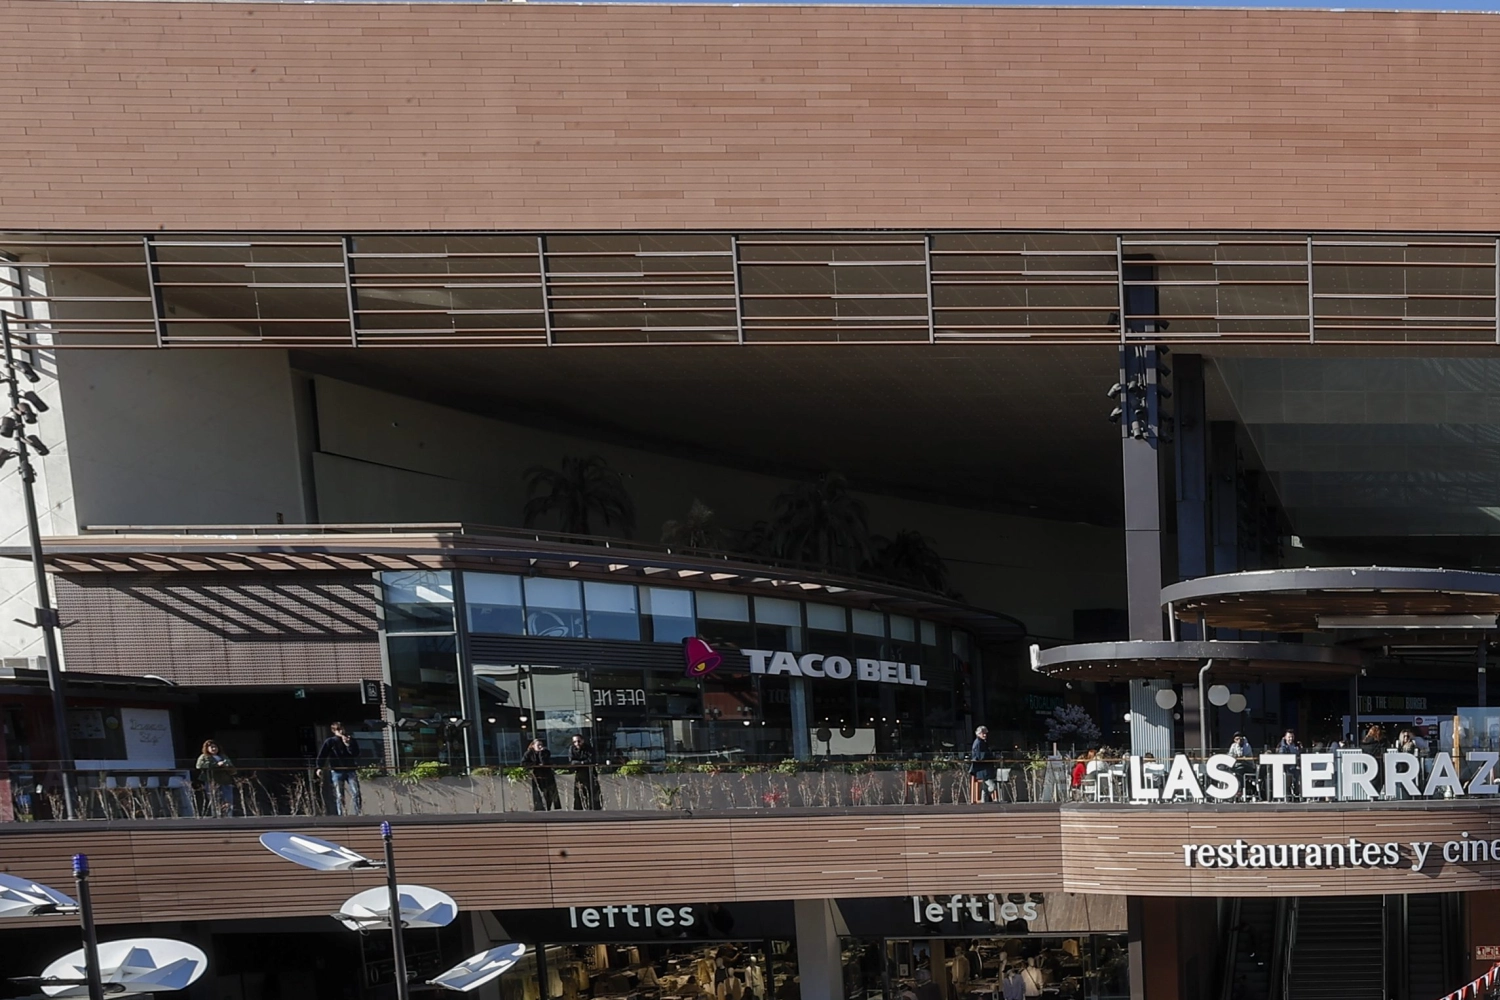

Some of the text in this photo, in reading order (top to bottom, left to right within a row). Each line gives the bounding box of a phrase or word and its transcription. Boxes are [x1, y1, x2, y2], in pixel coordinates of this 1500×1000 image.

[740, 648, 928, 687] TACO BELL
[1130, 753, 1240, 800] LAS
[1182, 838, 1399, 868] restaurantes
[1410, 841, 1433, 871] y
[912, 893, 1038, 923] lefties
